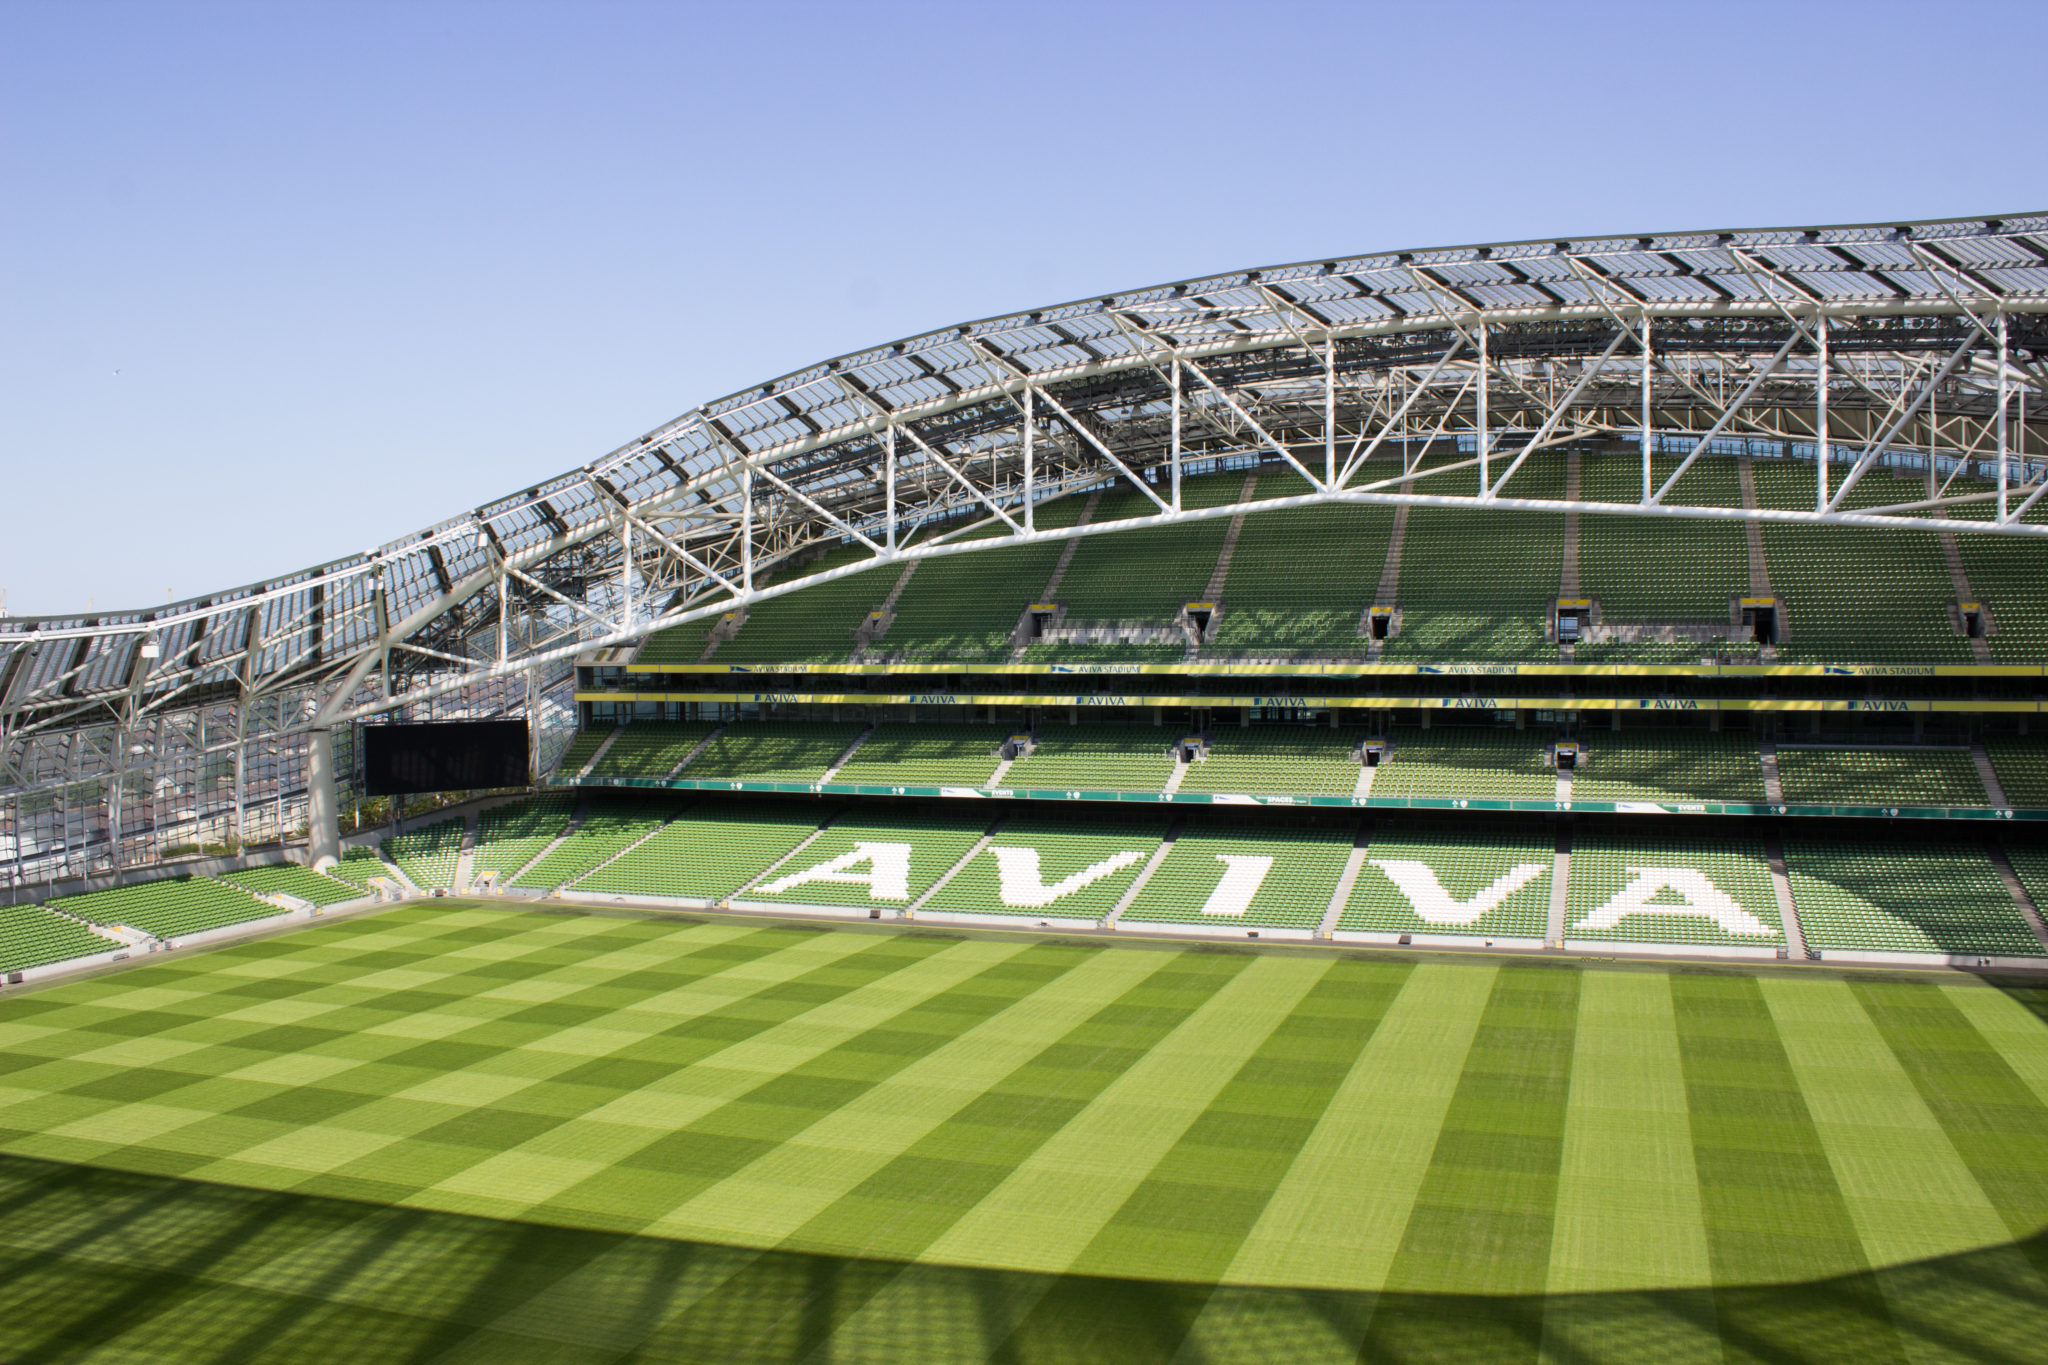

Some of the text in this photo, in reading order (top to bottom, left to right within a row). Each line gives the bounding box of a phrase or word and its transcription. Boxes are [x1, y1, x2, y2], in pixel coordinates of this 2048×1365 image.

[1078, 665, 1140, 673] AVIVA STADIUM
[1448, 666, 1517, 674] AVIVA STADIUM
[1858, 666, 1934, 675] AVIVA STADIUM
[764, 694, 798, 703] AVIVA
[920, 695, 956, 704] AVIVA
[1088, 696, 1126, 705] AVIVA
[1266, 697, 1307, 707] AVIVA
[1455, 698, 1498, 708] AVIVA
[1653, 699, 1698, 710] AVIVA
[1862, 701, 1909, 711] AVIVA
[753, 841, 1780, 938] AVIVA
